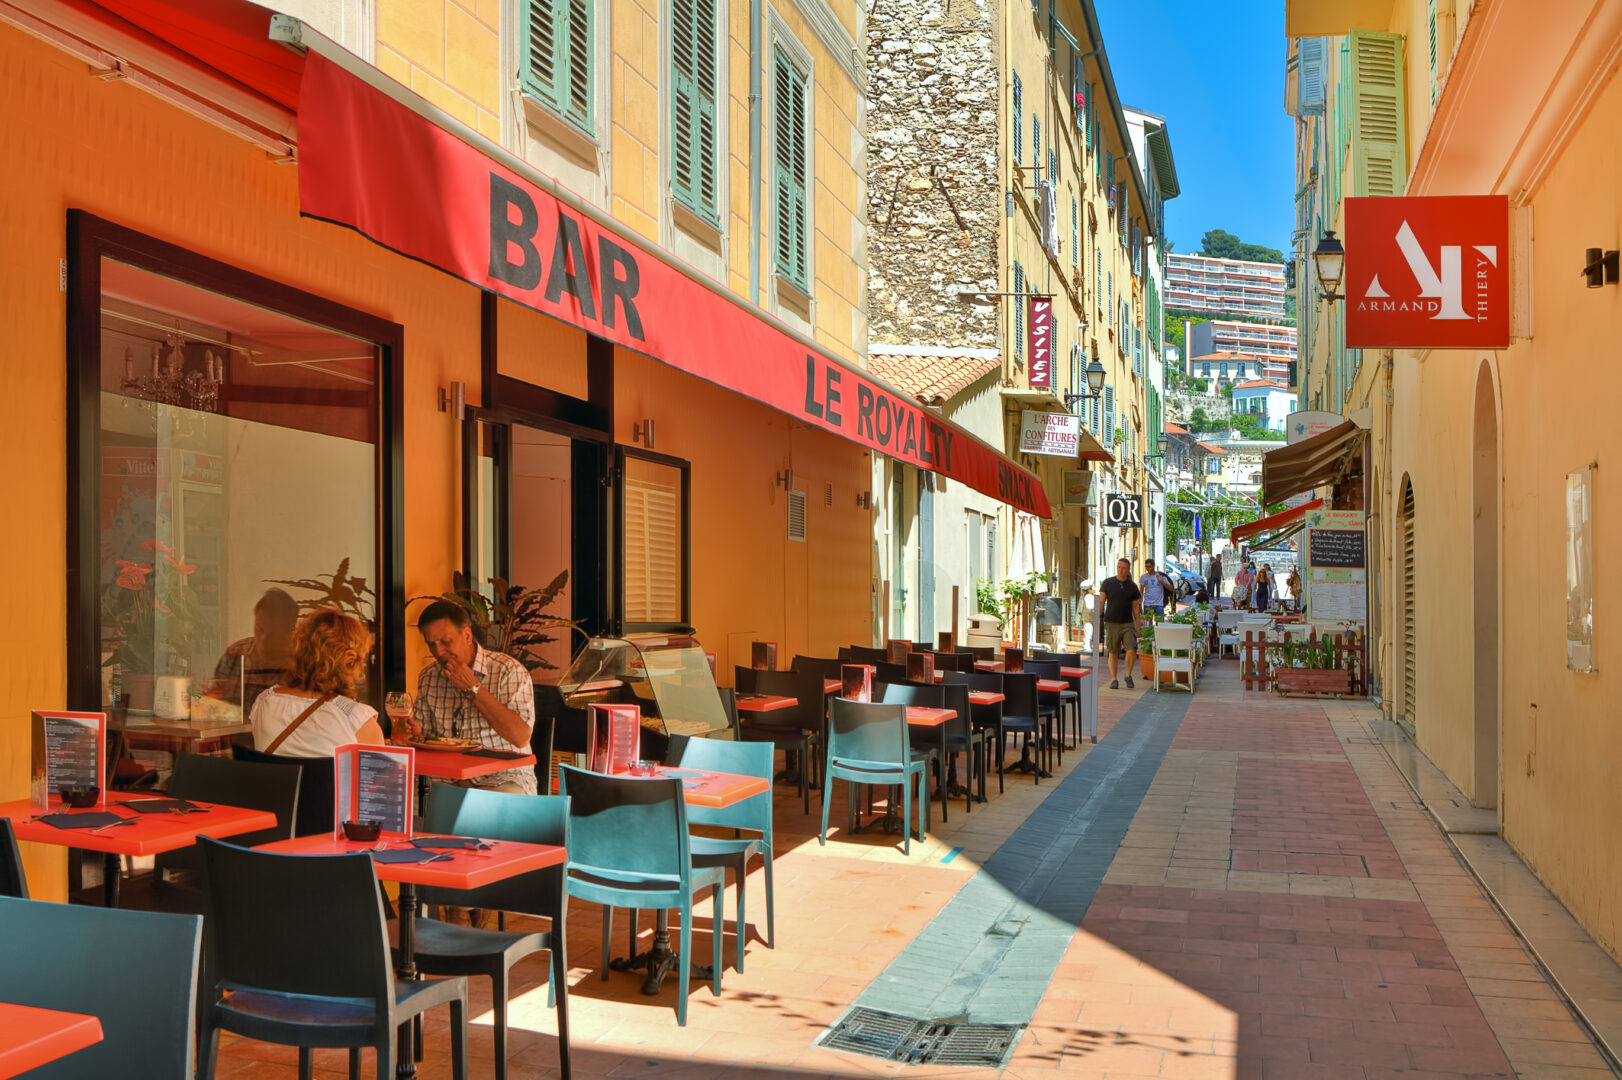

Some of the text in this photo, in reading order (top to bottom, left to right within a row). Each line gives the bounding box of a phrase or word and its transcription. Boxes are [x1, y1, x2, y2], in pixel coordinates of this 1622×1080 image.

[488, 171, 645, 342] BAR
[1357, 301, 1439, 312] ARMAND
[1477, 258, 1488, 323] THIERY
[1031, 302, 1050, 382] VISITEZ
[805, 354, 953, 472] LE ROYALTY
[1025, 429, 1077, 443] CONFITURES
[1034, 414, 1069, 426] L'ARCHE
[998, 460, 1034, 511] SNACK
[1108, 499, 1140, 522] OR
